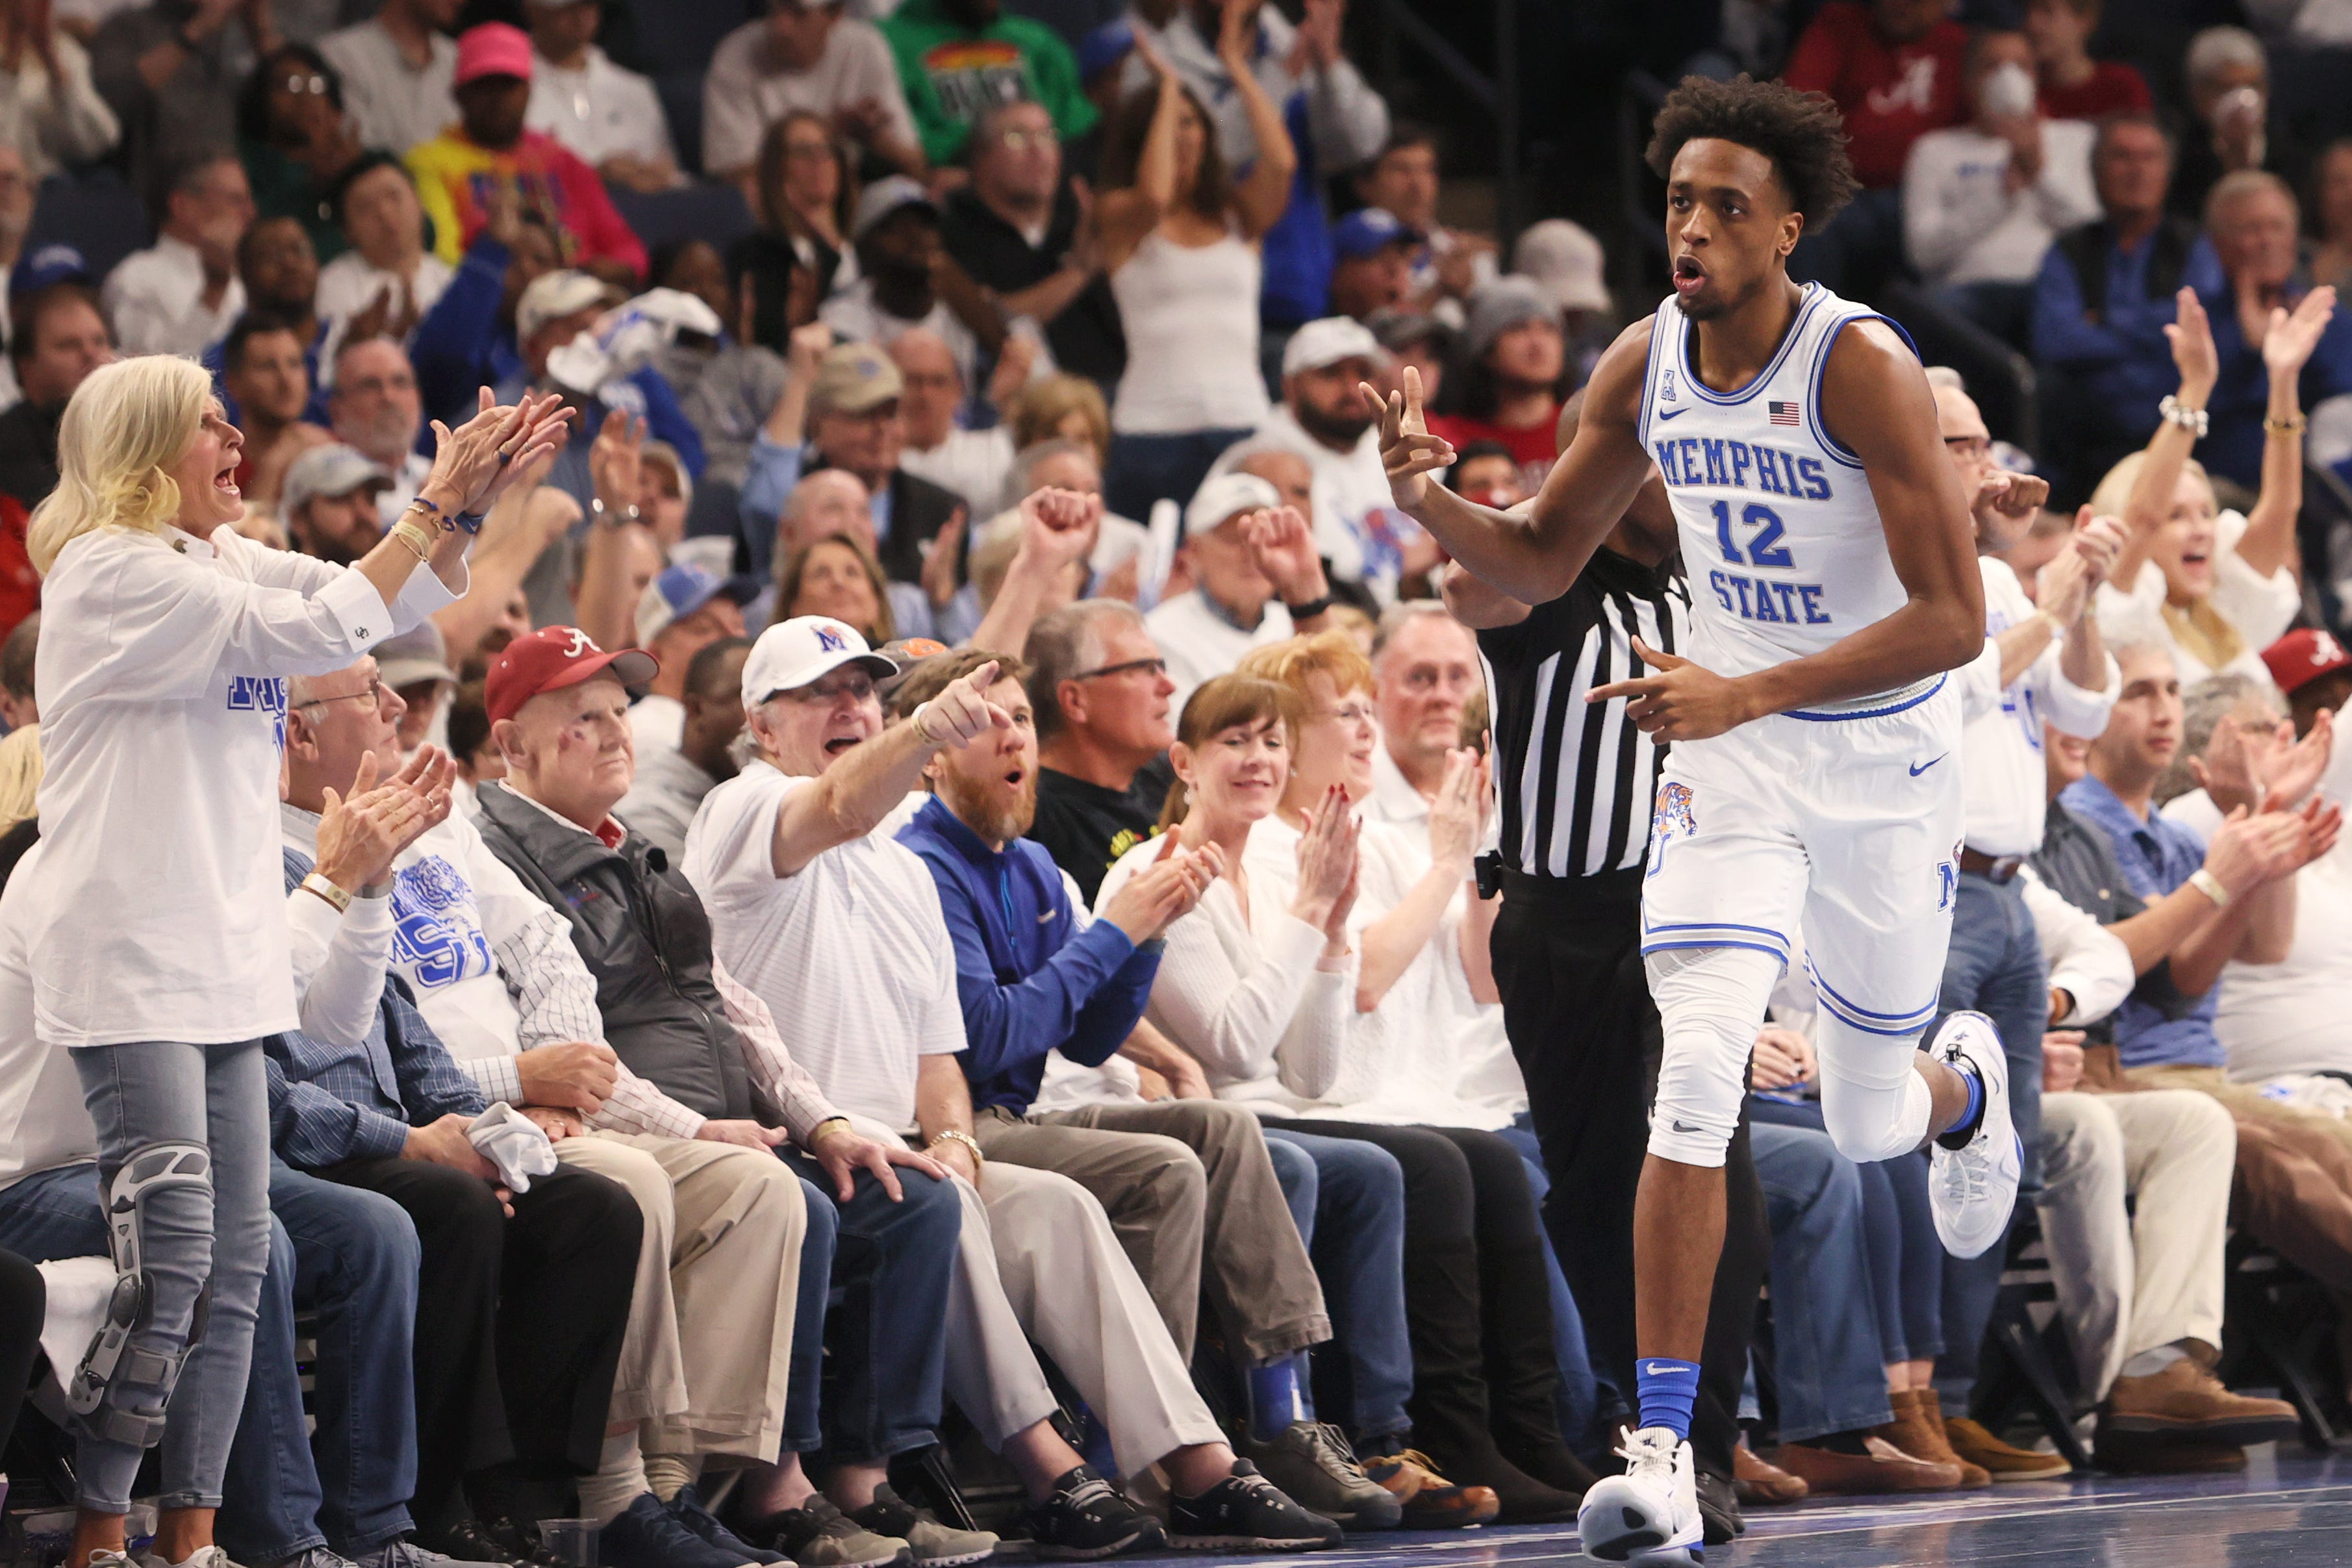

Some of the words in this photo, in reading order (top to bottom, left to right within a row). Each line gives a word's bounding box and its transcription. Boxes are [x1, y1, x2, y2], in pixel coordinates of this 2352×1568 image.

[1654, 437, 1833, 501] MEMPHIS
[1710, 499, 1796, 568] 12
[1710, 568, 1832, 624] STATE
